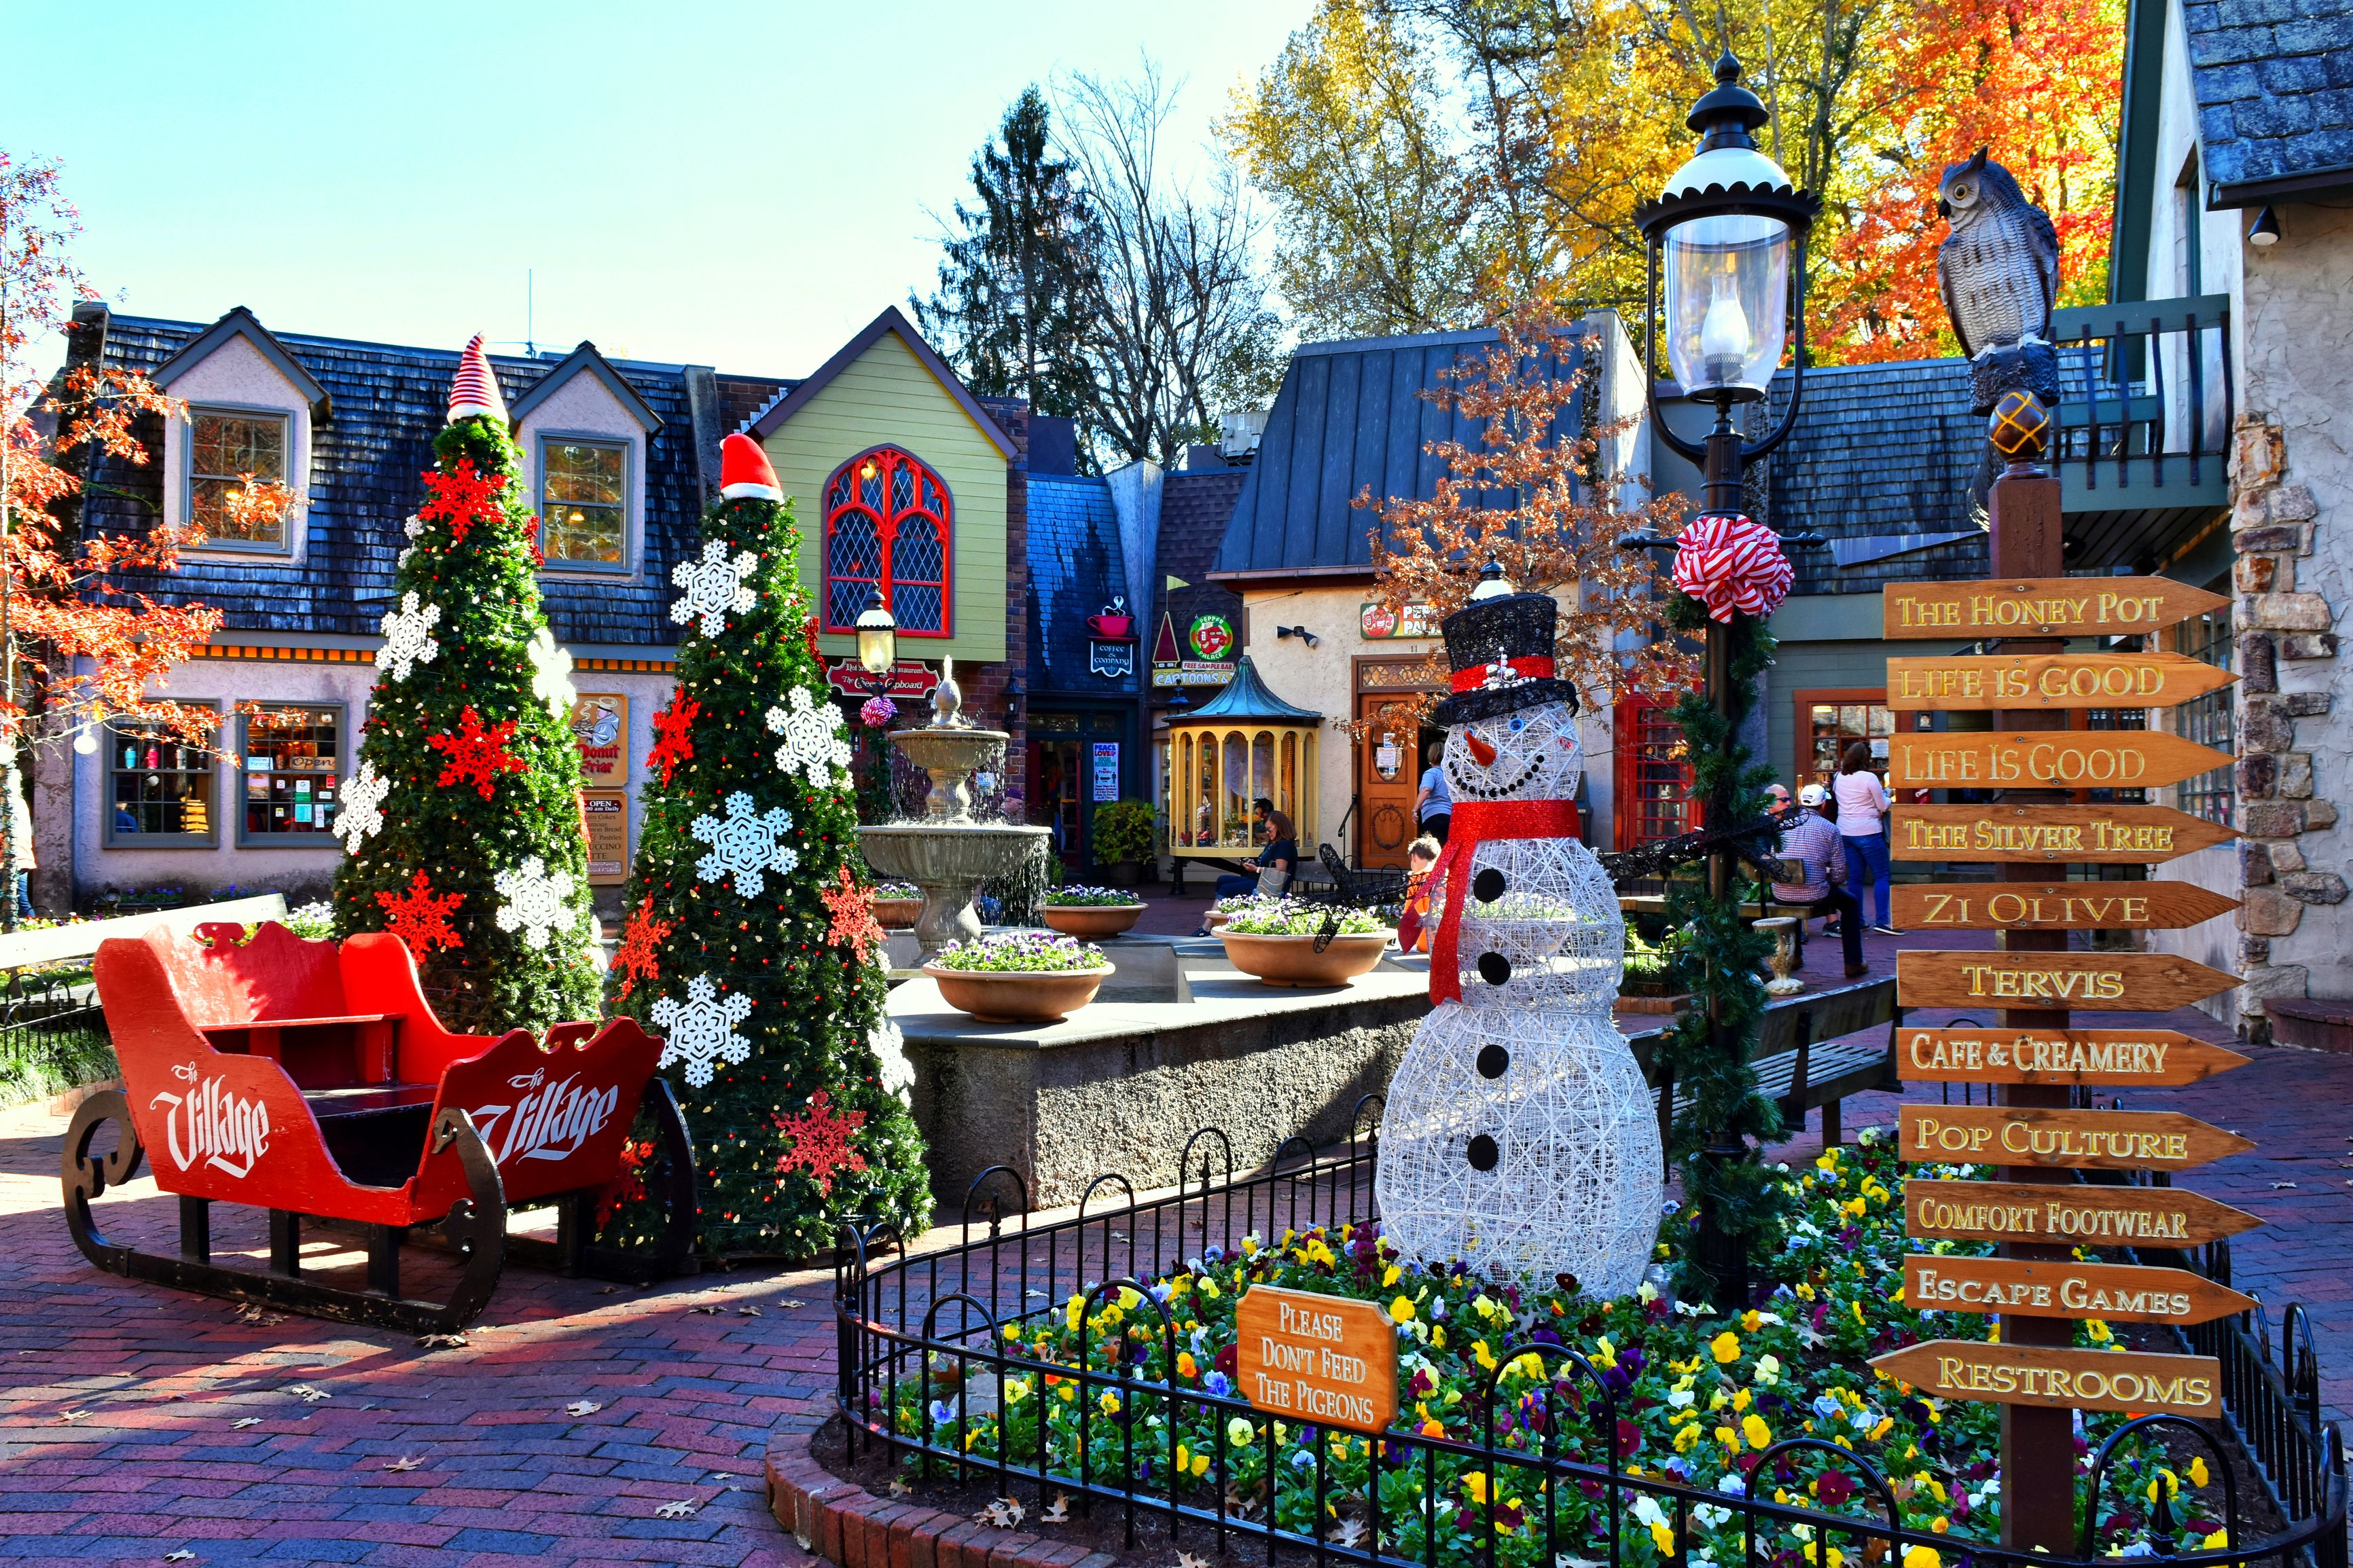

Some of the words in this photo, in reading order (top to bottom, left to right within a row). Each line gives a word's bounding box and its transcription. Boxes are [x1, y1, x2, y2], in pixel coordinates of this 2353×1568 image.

[1895, 596, 1960, 626] THE
[1969, 594, 2087, 625] HONEY
[2096, 592, 2163, 622] POT
[1198, 651, 1223, 660] PALACE
[842, 675, 854, 684] The
[885, 678, 923, 690] Cpboard
[1155, 672, 1219, 685] CARTOONS
[1221, 672, 1229, 684] &
[1899, 668, 1983, 699] LIFE
[1993, 668, 2030, 698] IS
[2038, 665, 2165, 697] GOOD
[293, 757, 335, 769] Open
[574, 744, 620, 759] Donut
[579, 760, 613, 775] Friar
[1902, 745, 1979, 780] LIFE
[2028, 744, 2145, 780] GOOD
[1903, 819, 1967, 850] THE
[1975, 819, 2083, 851] SILVER
[2090, 820, 2174, 852] TREE
[1988, 893, 2149, 923] OLIVE
[1962, 966, 2124, 998] TERVIS
[1910, 1034, 1982, 1071] CAFE
[1987, 1043, 2009, 1065] &
[2013, 1034, 2168, 1074] CREAMERY
[171, 1061, 198, 1084] The
[507, 1067, 544, 1090] The
[149, 1074, 270, 1178] Village
[470, 1071, 618, 1165] Village
[1916, 1118, 1992, 1152] POP
[2000, 1121, 2188, 1159] CULTURE
[1918, 1198, 2037, 1233] COMFORT
[2045, 1201, 2189, 1239] FOOTWEAR
[1916, 1269, 2051, 1307] ESCAPE
[2060, 1277, 2191, 1315] GAMES
[1278, 1302, 1343, 1343] PLEASE
[1321, 1347, 1366, 1384] FEED
[1936, 1356, 2211, 1408] RESTROOMS
[1255, 1372, 1291, 1408] THE
[1296, 1380, 1374, 1425] PIGEONS
